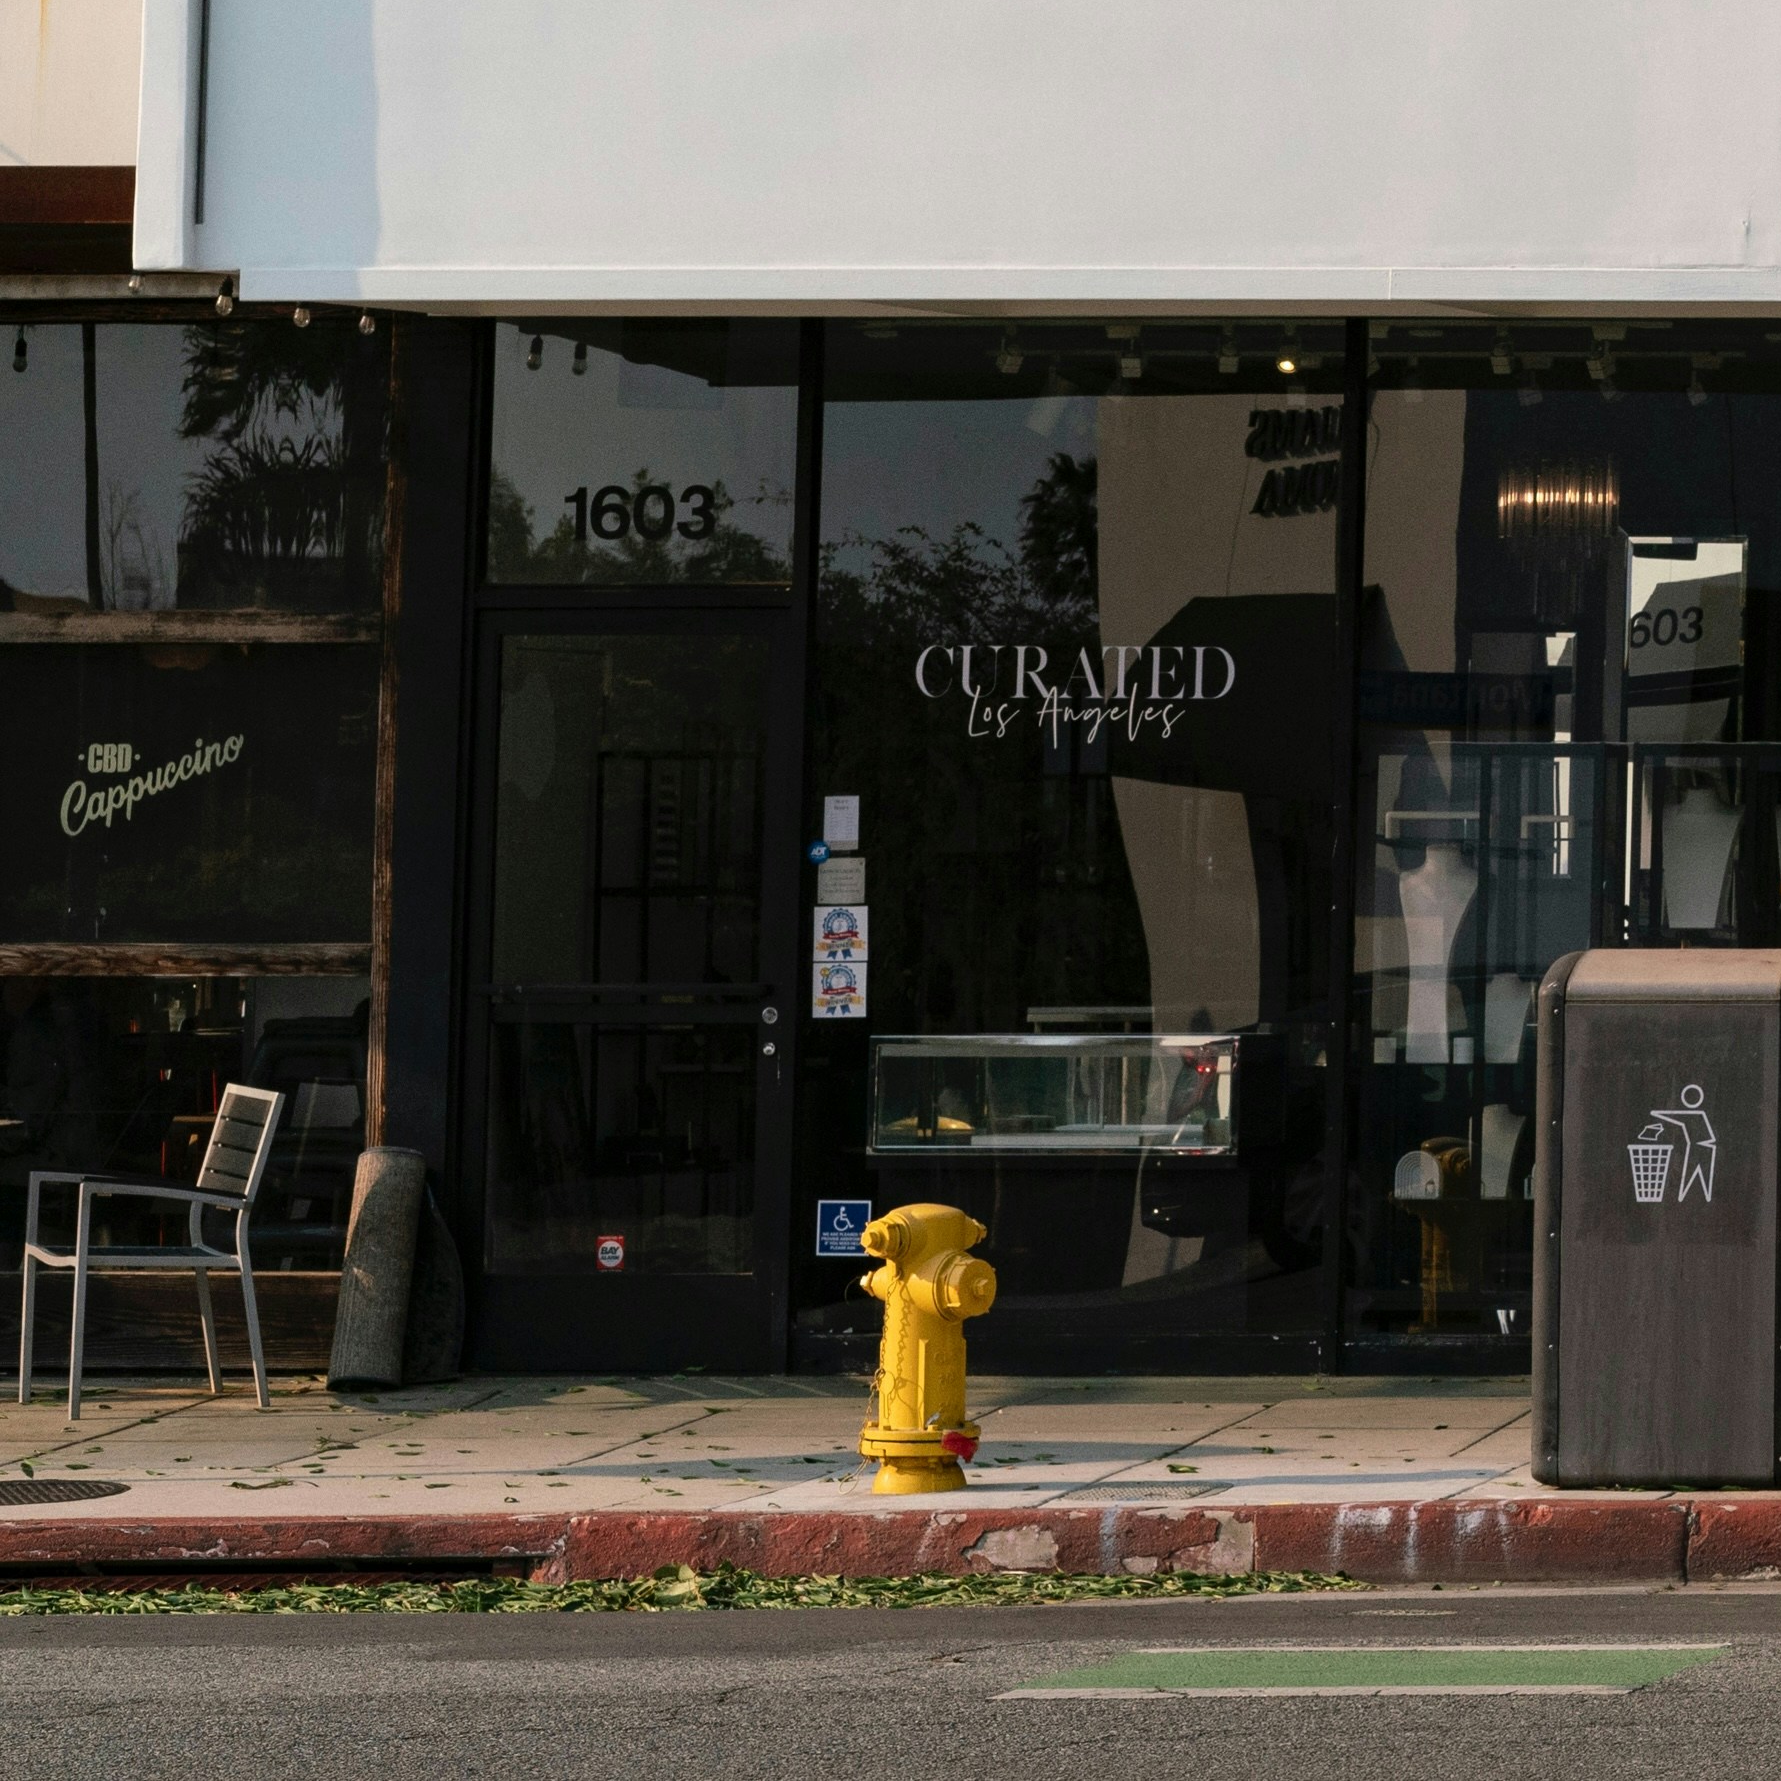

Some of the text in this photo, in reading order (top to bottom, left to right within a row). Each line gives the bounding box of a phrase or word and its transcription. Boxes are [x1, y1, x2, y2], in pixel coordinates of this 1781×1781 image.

[564, 485, 715, 541] 1603
[1630, 606, 1704, 648] 603
[915, 645, 1236, 699] CURATED
[968, 682, 1186, 749] Los Angeles
[87, 743, 133, 774] CBD
[60, 733, 245, 837] Cappuccino
[810, 846, 827, 856] ADT
[600, 1246, 620, 1255] BAY
